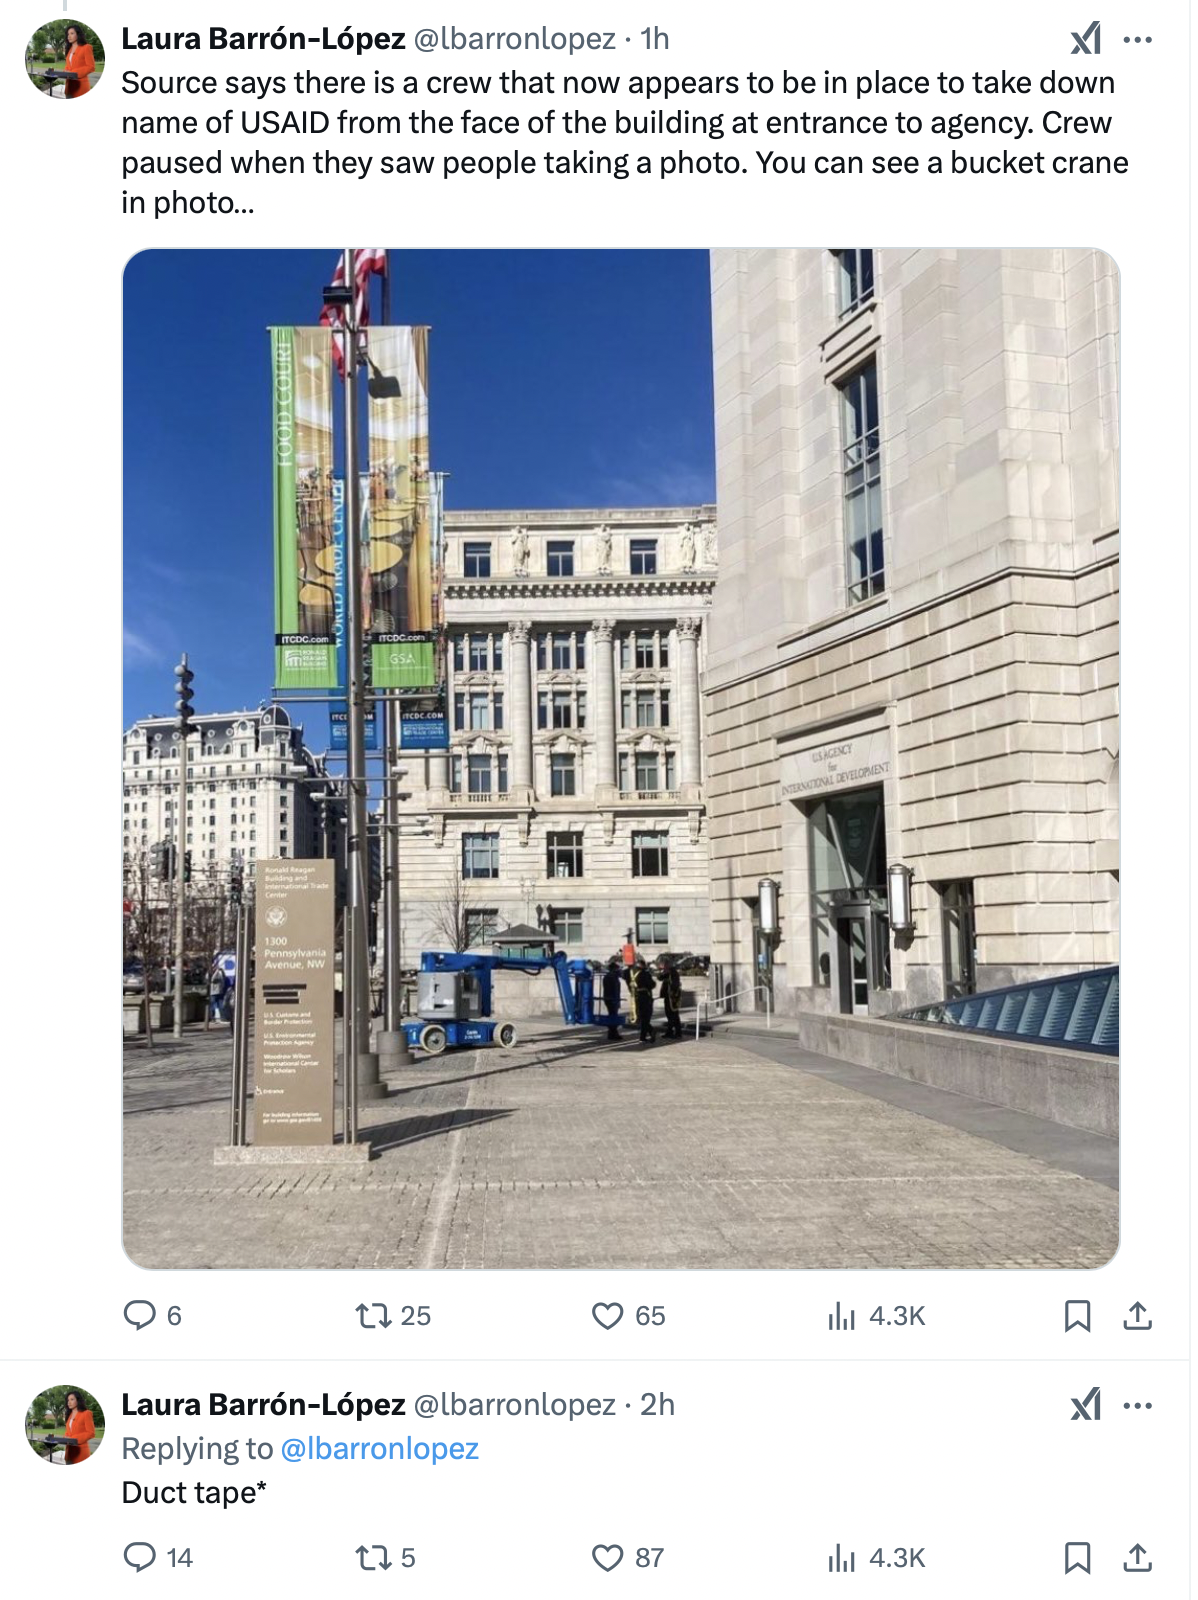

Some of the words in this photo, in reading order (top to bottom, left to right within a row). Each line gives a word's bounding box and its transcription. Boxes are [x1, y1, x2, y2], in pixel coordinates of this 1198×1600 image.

[277, 343, 292, 405] COURT
[277, 410, 292, 466] FOOD
[281, 635, 329, 644] ITCDC.com
[379, 634, 426, 643] ITCDC.com
[390, 652, 415, 664] GSA
[402, 712, 444, 720] ITCDC.COM
[836, 762, 891, 784] DEVELOPMENT
[265, 937, 287, 945] 1300
[264, 948, 326, 959] Pennsylvania
[265, 960, 304, 970] Avenue,
[307, 960, 325, 968] NW
